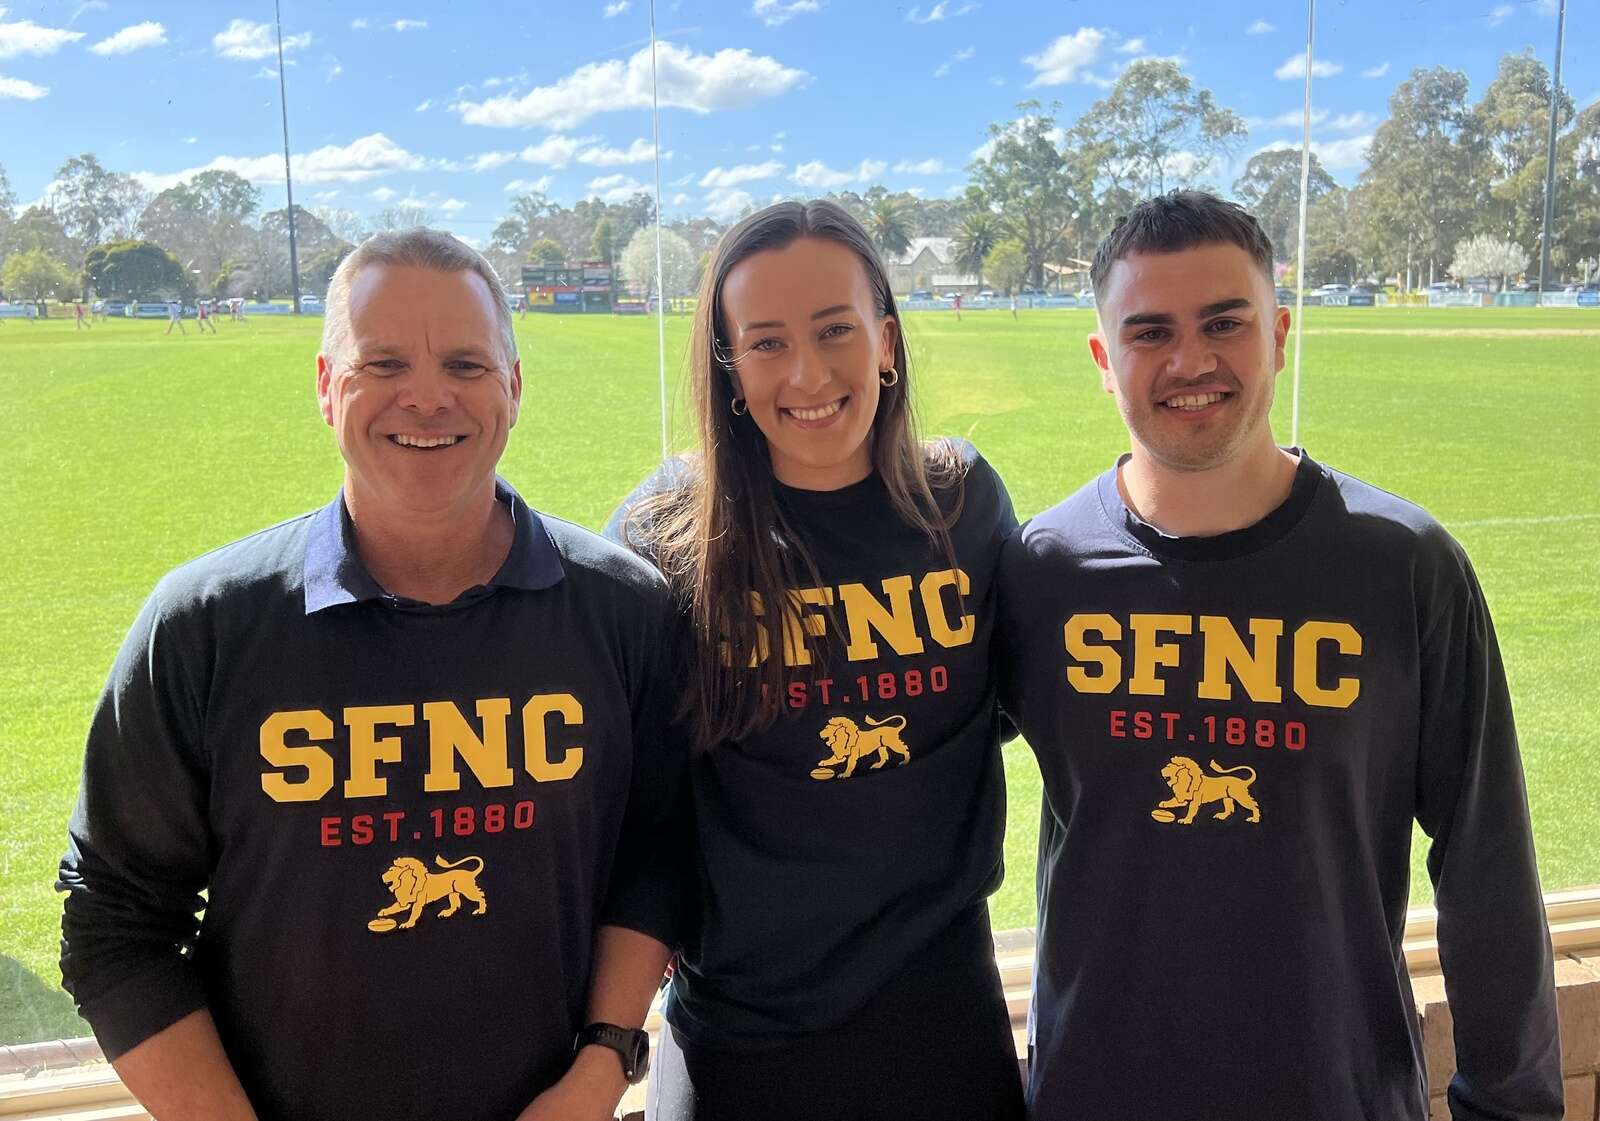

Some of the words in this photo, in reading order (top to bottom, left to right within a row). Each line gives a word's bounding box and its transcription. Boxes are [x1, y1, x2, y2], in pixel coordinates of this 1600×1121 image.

[1063, 613, 1363, 709] SFNC
[760, 665, 949, 708] ST.1880
[259, 693, 585, 803] SFNC
[1109, 710, 1307, 751] EST.1880
[320, 800, 536, 848] EST.1880
